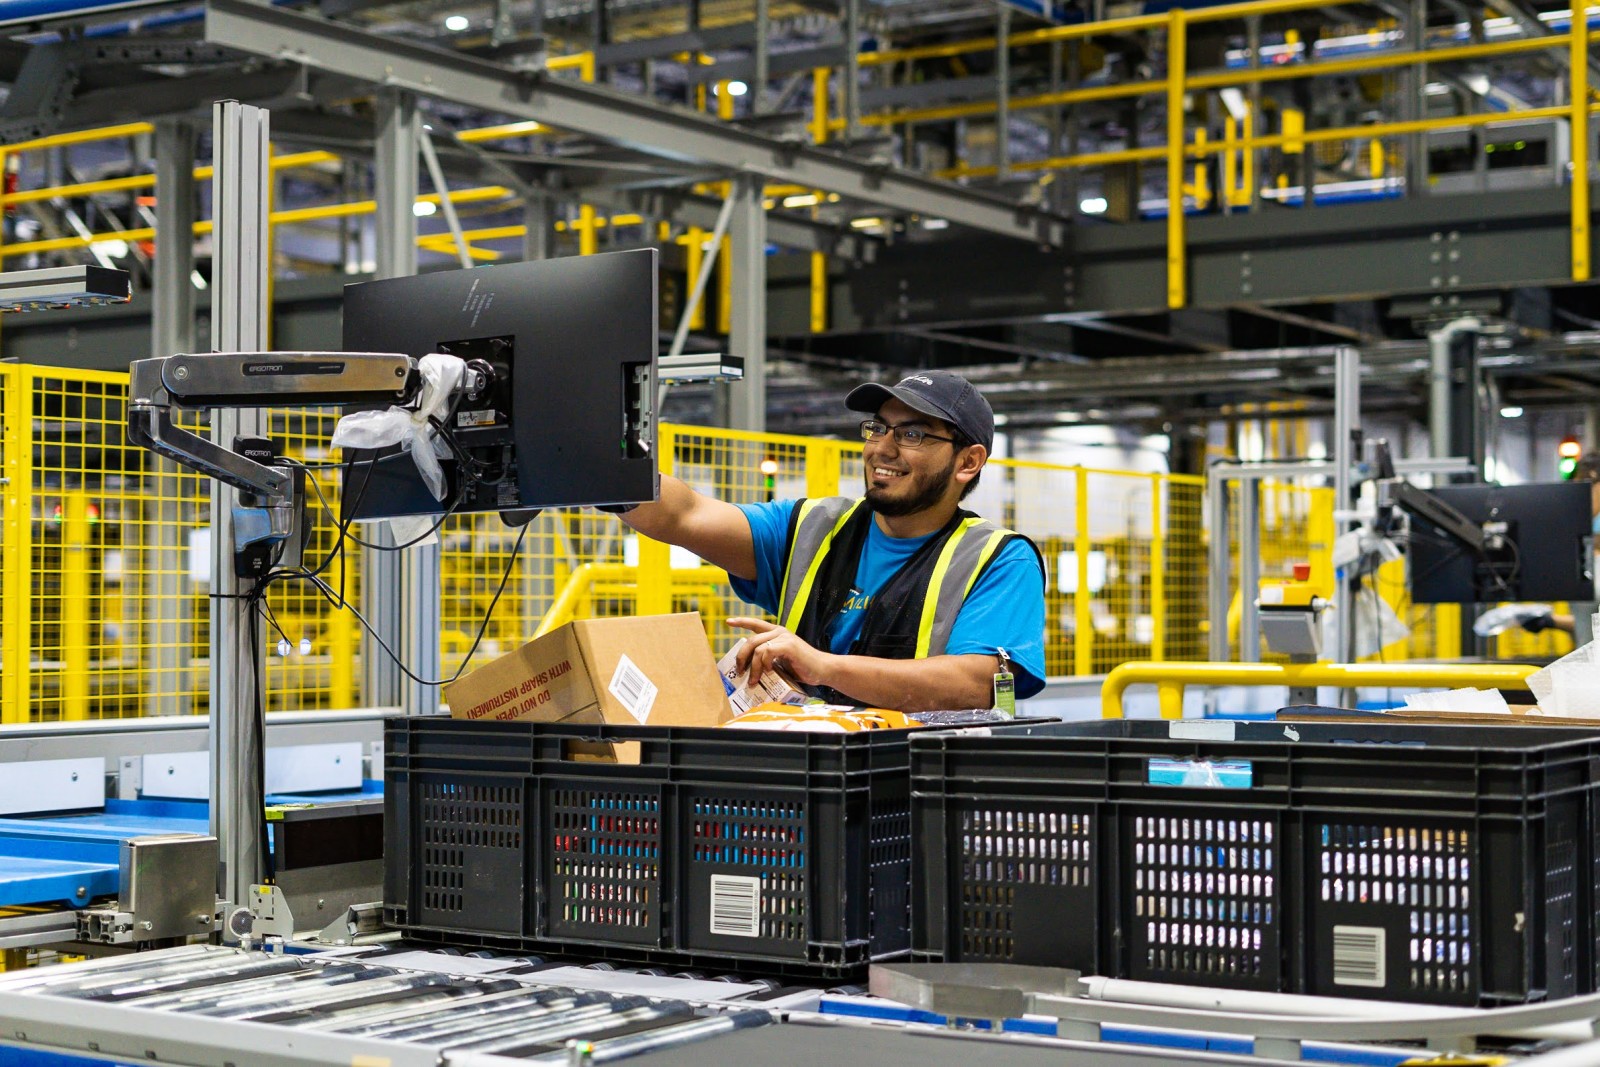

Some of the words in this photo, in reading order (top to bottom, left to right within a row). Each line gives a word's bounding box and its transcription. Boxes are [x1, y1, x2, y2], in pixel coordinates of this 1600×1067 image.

[245, 449, 271, 457] ERGOTRON
[548, 660, 572, 680] WITH
[520, 671, 549, 695] SHARP
[466, 686, 518, 719] INSTRUMENT
[520, 696, 537, 713] NOT
[537, 689, 551, 705] DO
